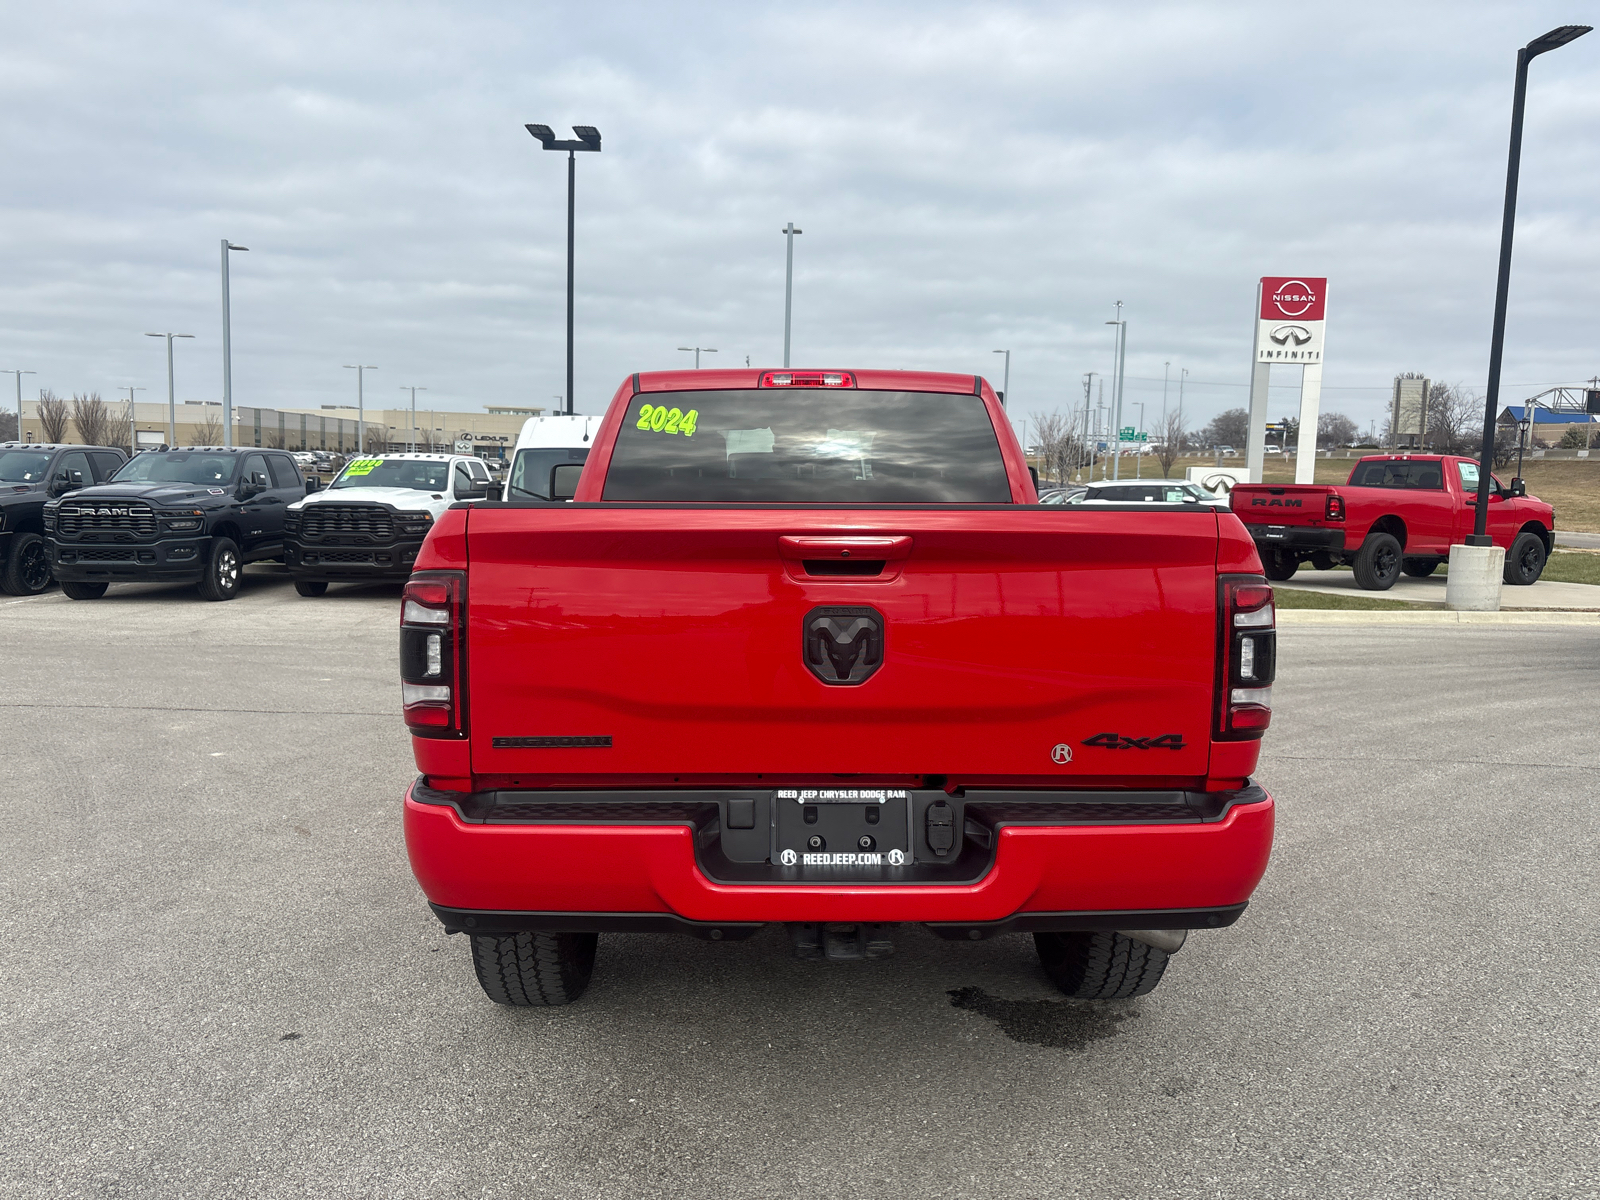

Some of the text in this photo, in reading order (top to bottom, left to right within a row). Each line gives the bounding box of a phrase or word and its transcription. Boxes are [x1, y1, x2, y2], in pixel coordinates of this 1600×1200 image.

[1260, 350, 1320, 359] INFINITI
[636, 404, 699, 437] 2024
[1252, 498, 1302, 507] RAM
[80, 507, 128, 516] RAM
[778, 790, 906, 799] REED JEEP CHRYSLER DODGE RAM
[803, 853, 881, 865] REEDJEEP.COM
